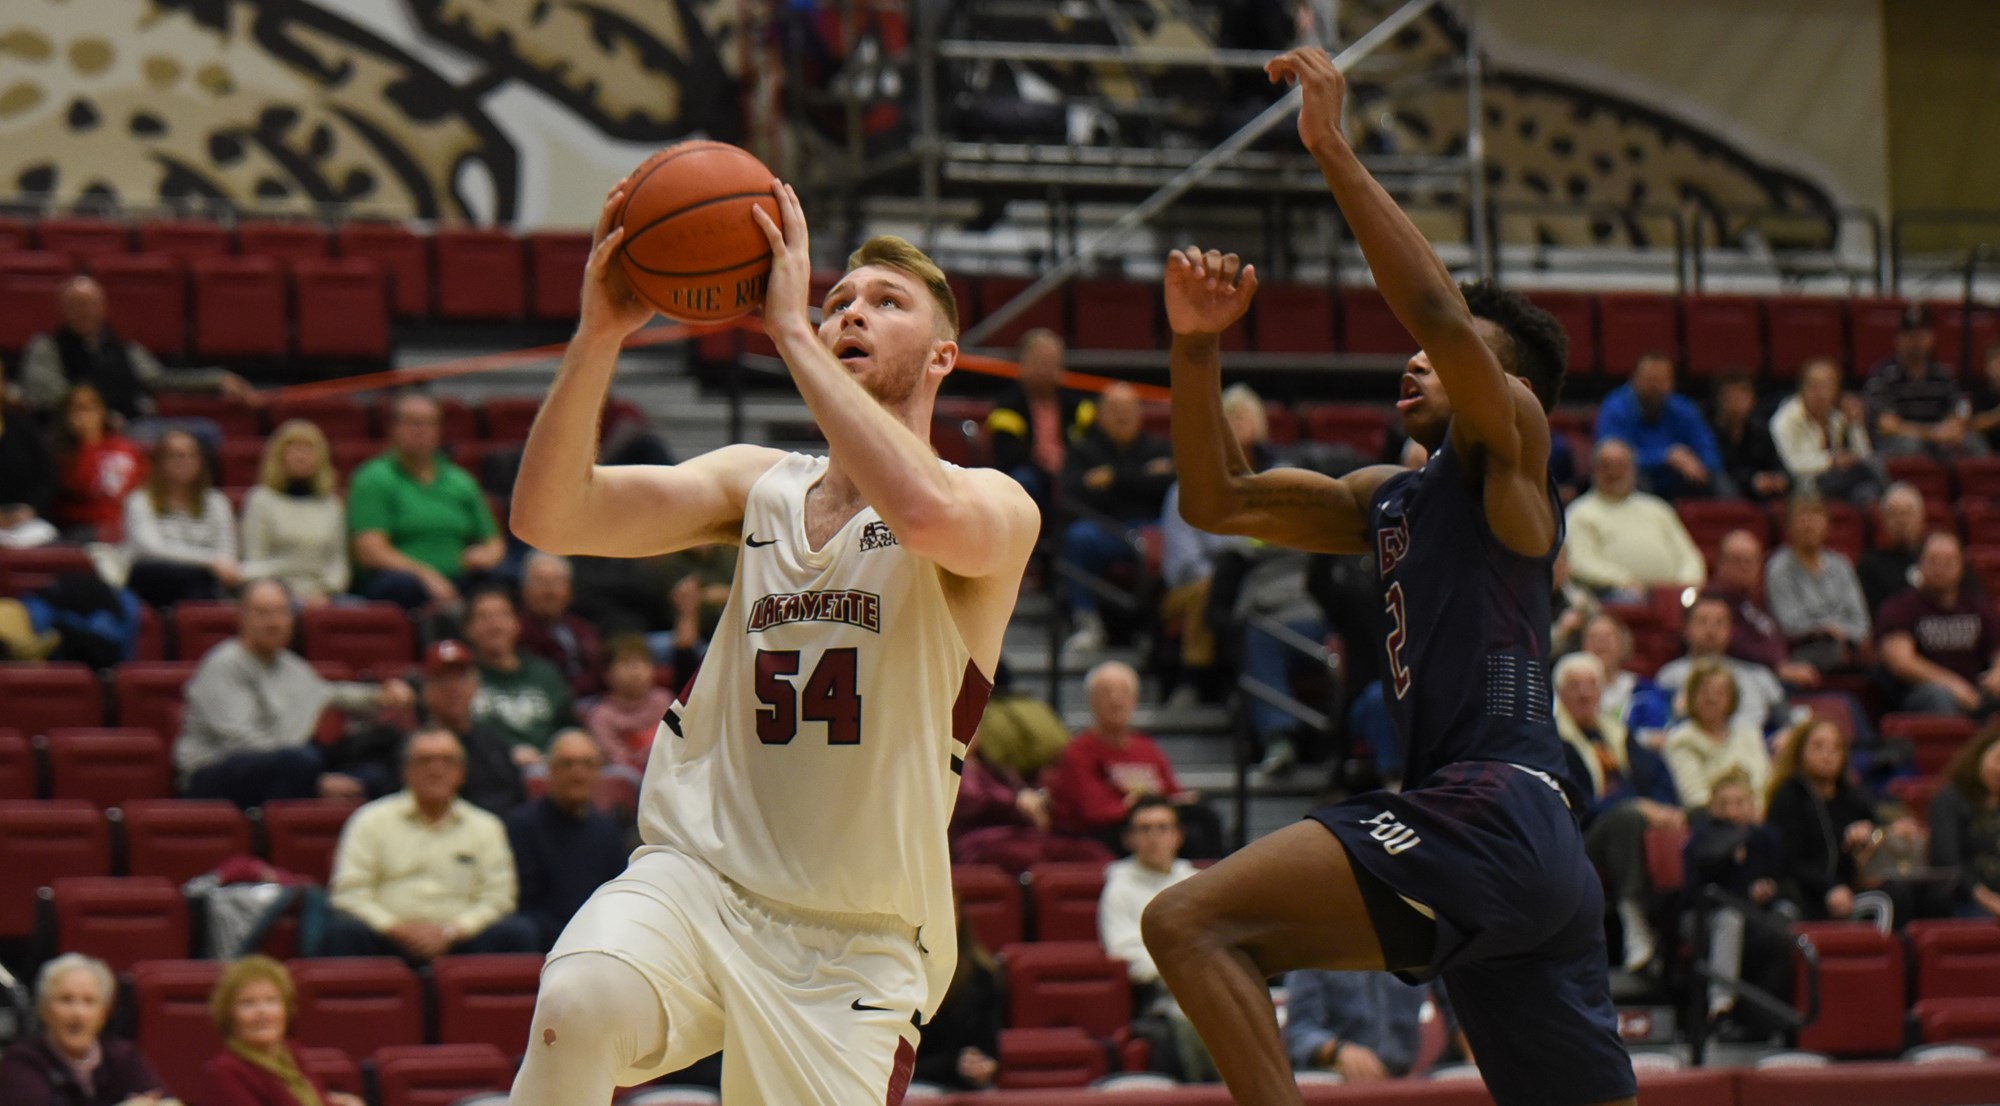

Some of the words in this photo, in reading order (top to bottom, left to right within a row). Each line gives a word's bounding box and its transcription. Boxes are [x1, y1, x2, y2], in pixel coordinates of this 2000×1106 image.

[668, 287, 721, 312] THE
[859, 531, 895, 546] PATRI
[747, 590, 880, 633] LAFAYETTE
[1385, 581, 1412, 700] 2
[755, 647, 862, 745] 54
[1359, 810, 1421, 855] FDU
